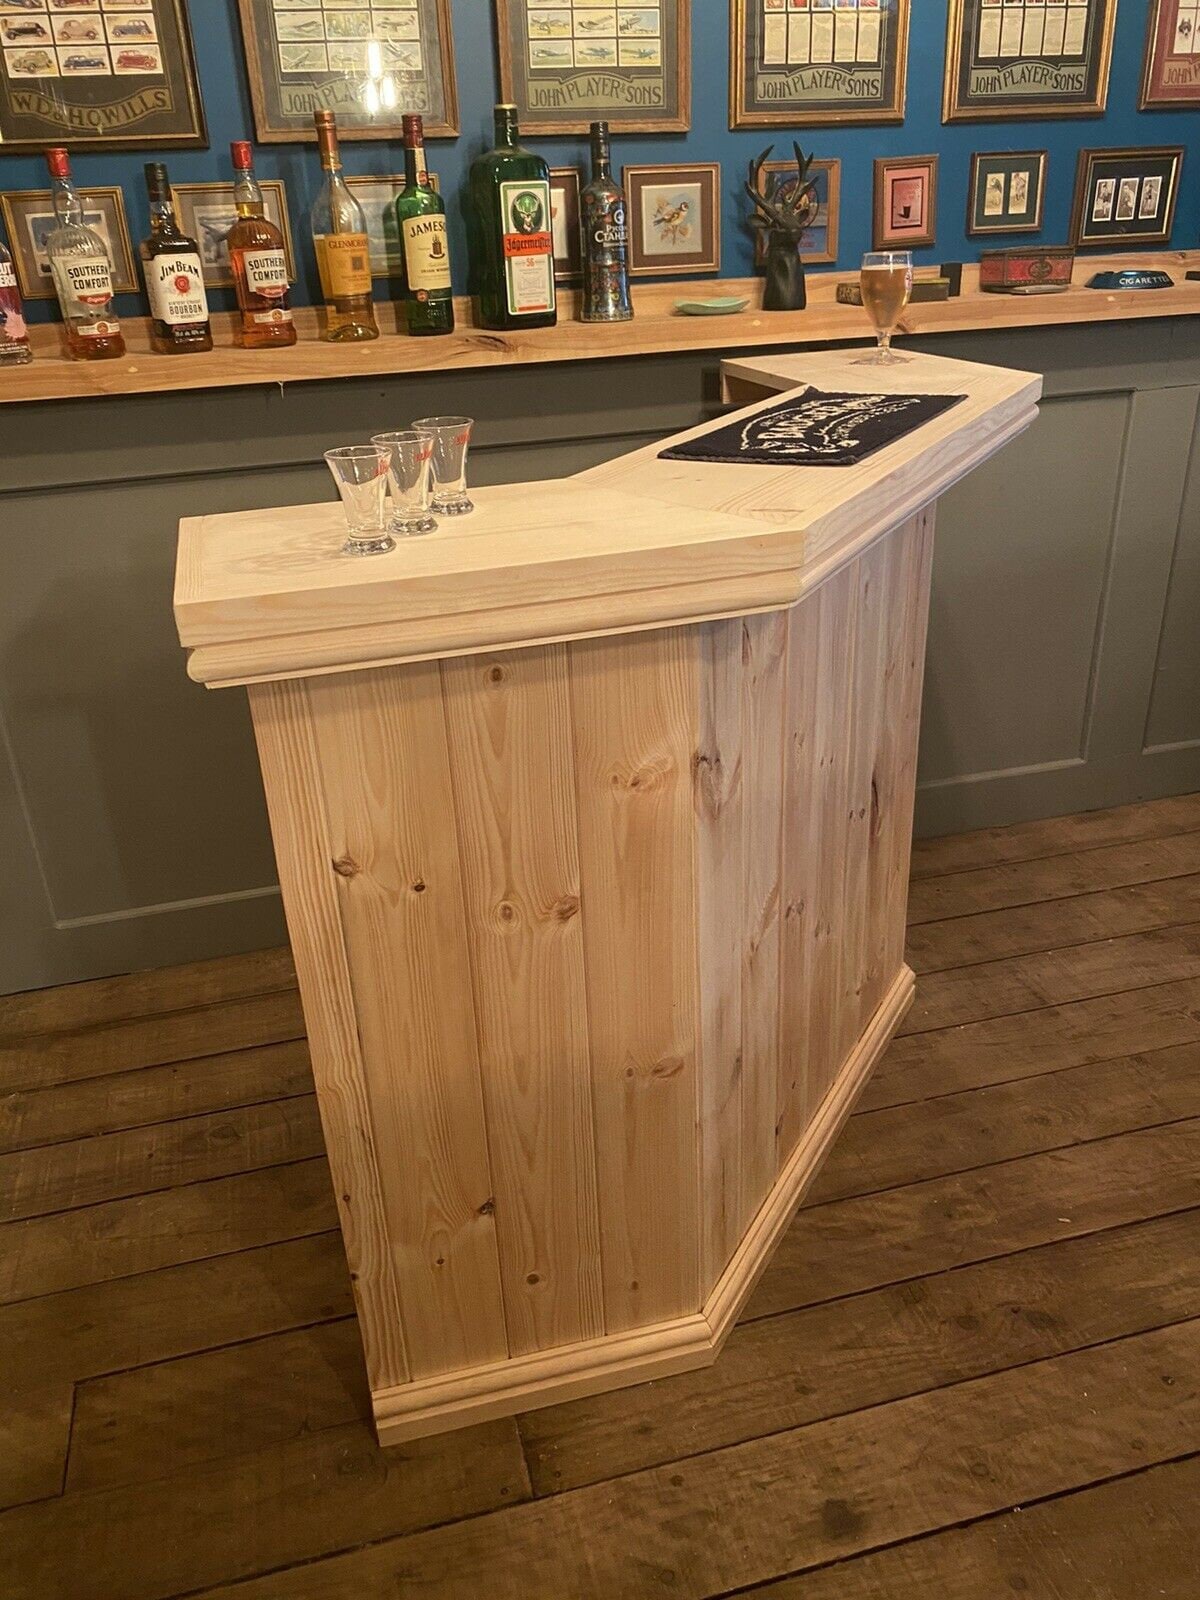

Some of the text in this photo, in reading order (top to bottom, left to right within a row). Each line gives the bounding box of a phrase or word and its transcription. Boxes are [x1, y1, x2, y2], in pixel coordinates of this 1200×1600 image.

[759, 81, 792, 98] JOHN
[792, 70, 842, 93] PLAYER
[846, 78, 880, 96] SONS
[971, 75, 1002, 93] JOHN
[1002, 65, 1049, 87] PLAYER
[1052, 73, 1083, 91] SONS
[1164, 67, 1192, 85] JOHN
[531, 88, 567, 107] JOHN
[566, 77, 620, 101] PLAYER
[625, 85, 661, 105] SONS
[285, 93, 324, 113] JOHN
[160, 260, 200, 281] JIM BEAM
[73, 276, 109, 290] COMFORT
[169, 303, 203, 315] BOURBON
